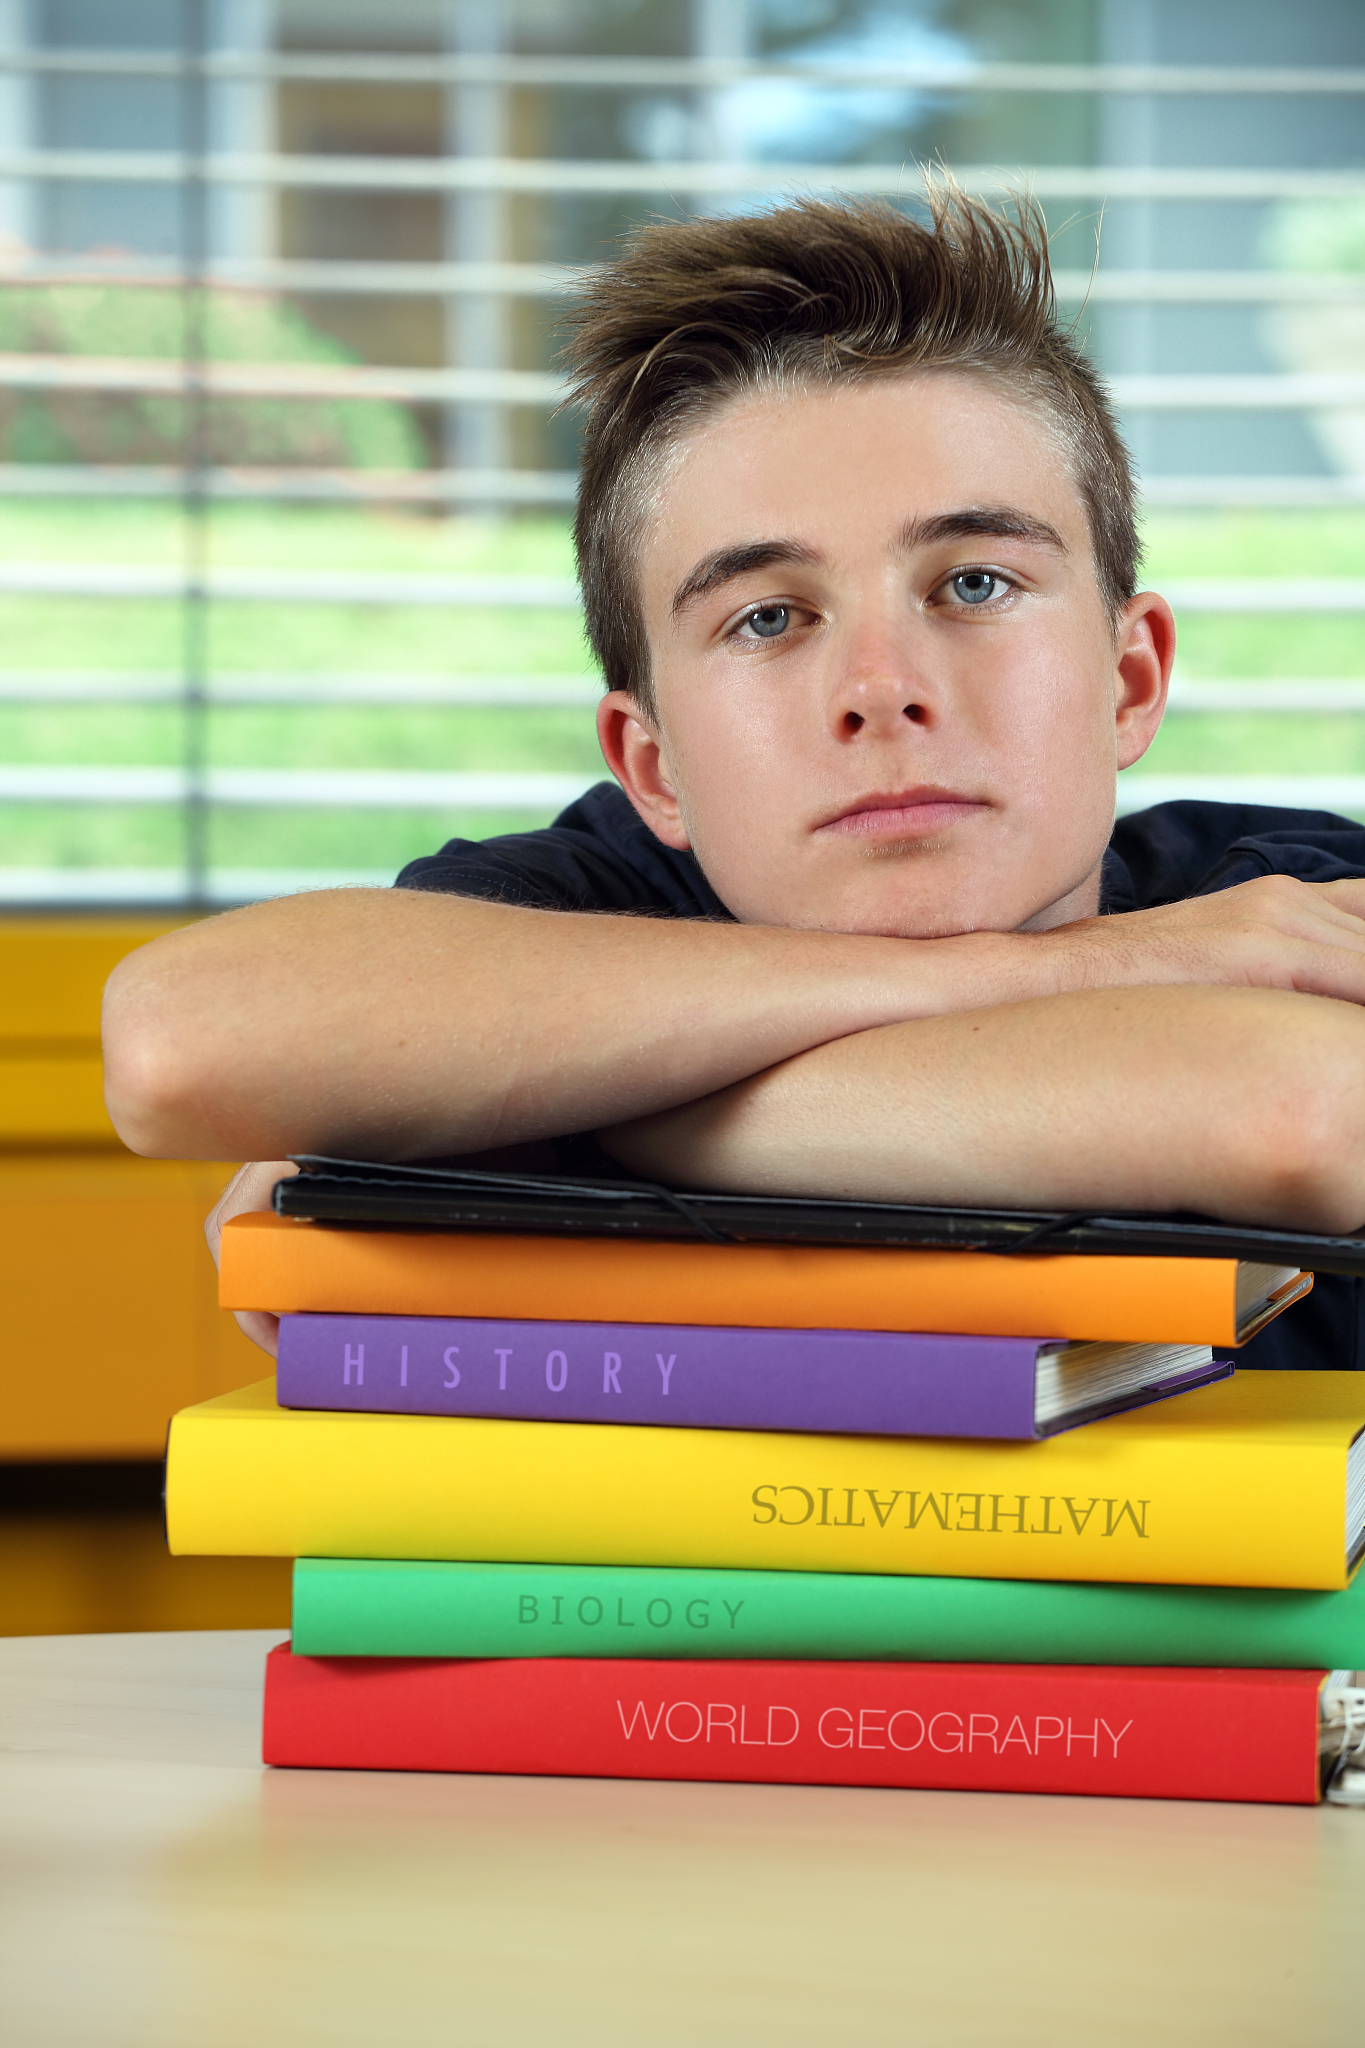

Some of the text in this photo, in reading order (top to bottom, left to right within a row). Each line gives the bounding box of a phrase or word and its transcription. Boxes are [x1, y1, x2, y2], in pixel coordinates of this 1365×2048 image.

[342, 1343, 677, 1396] HISTORY
[751, 1484, 1151, 1539] MATHEMATICS
[518, 1594, 745, 1630] BIOLOGY
[616, 1700, 1134, 1759] WORLD GEOGRAPHY
